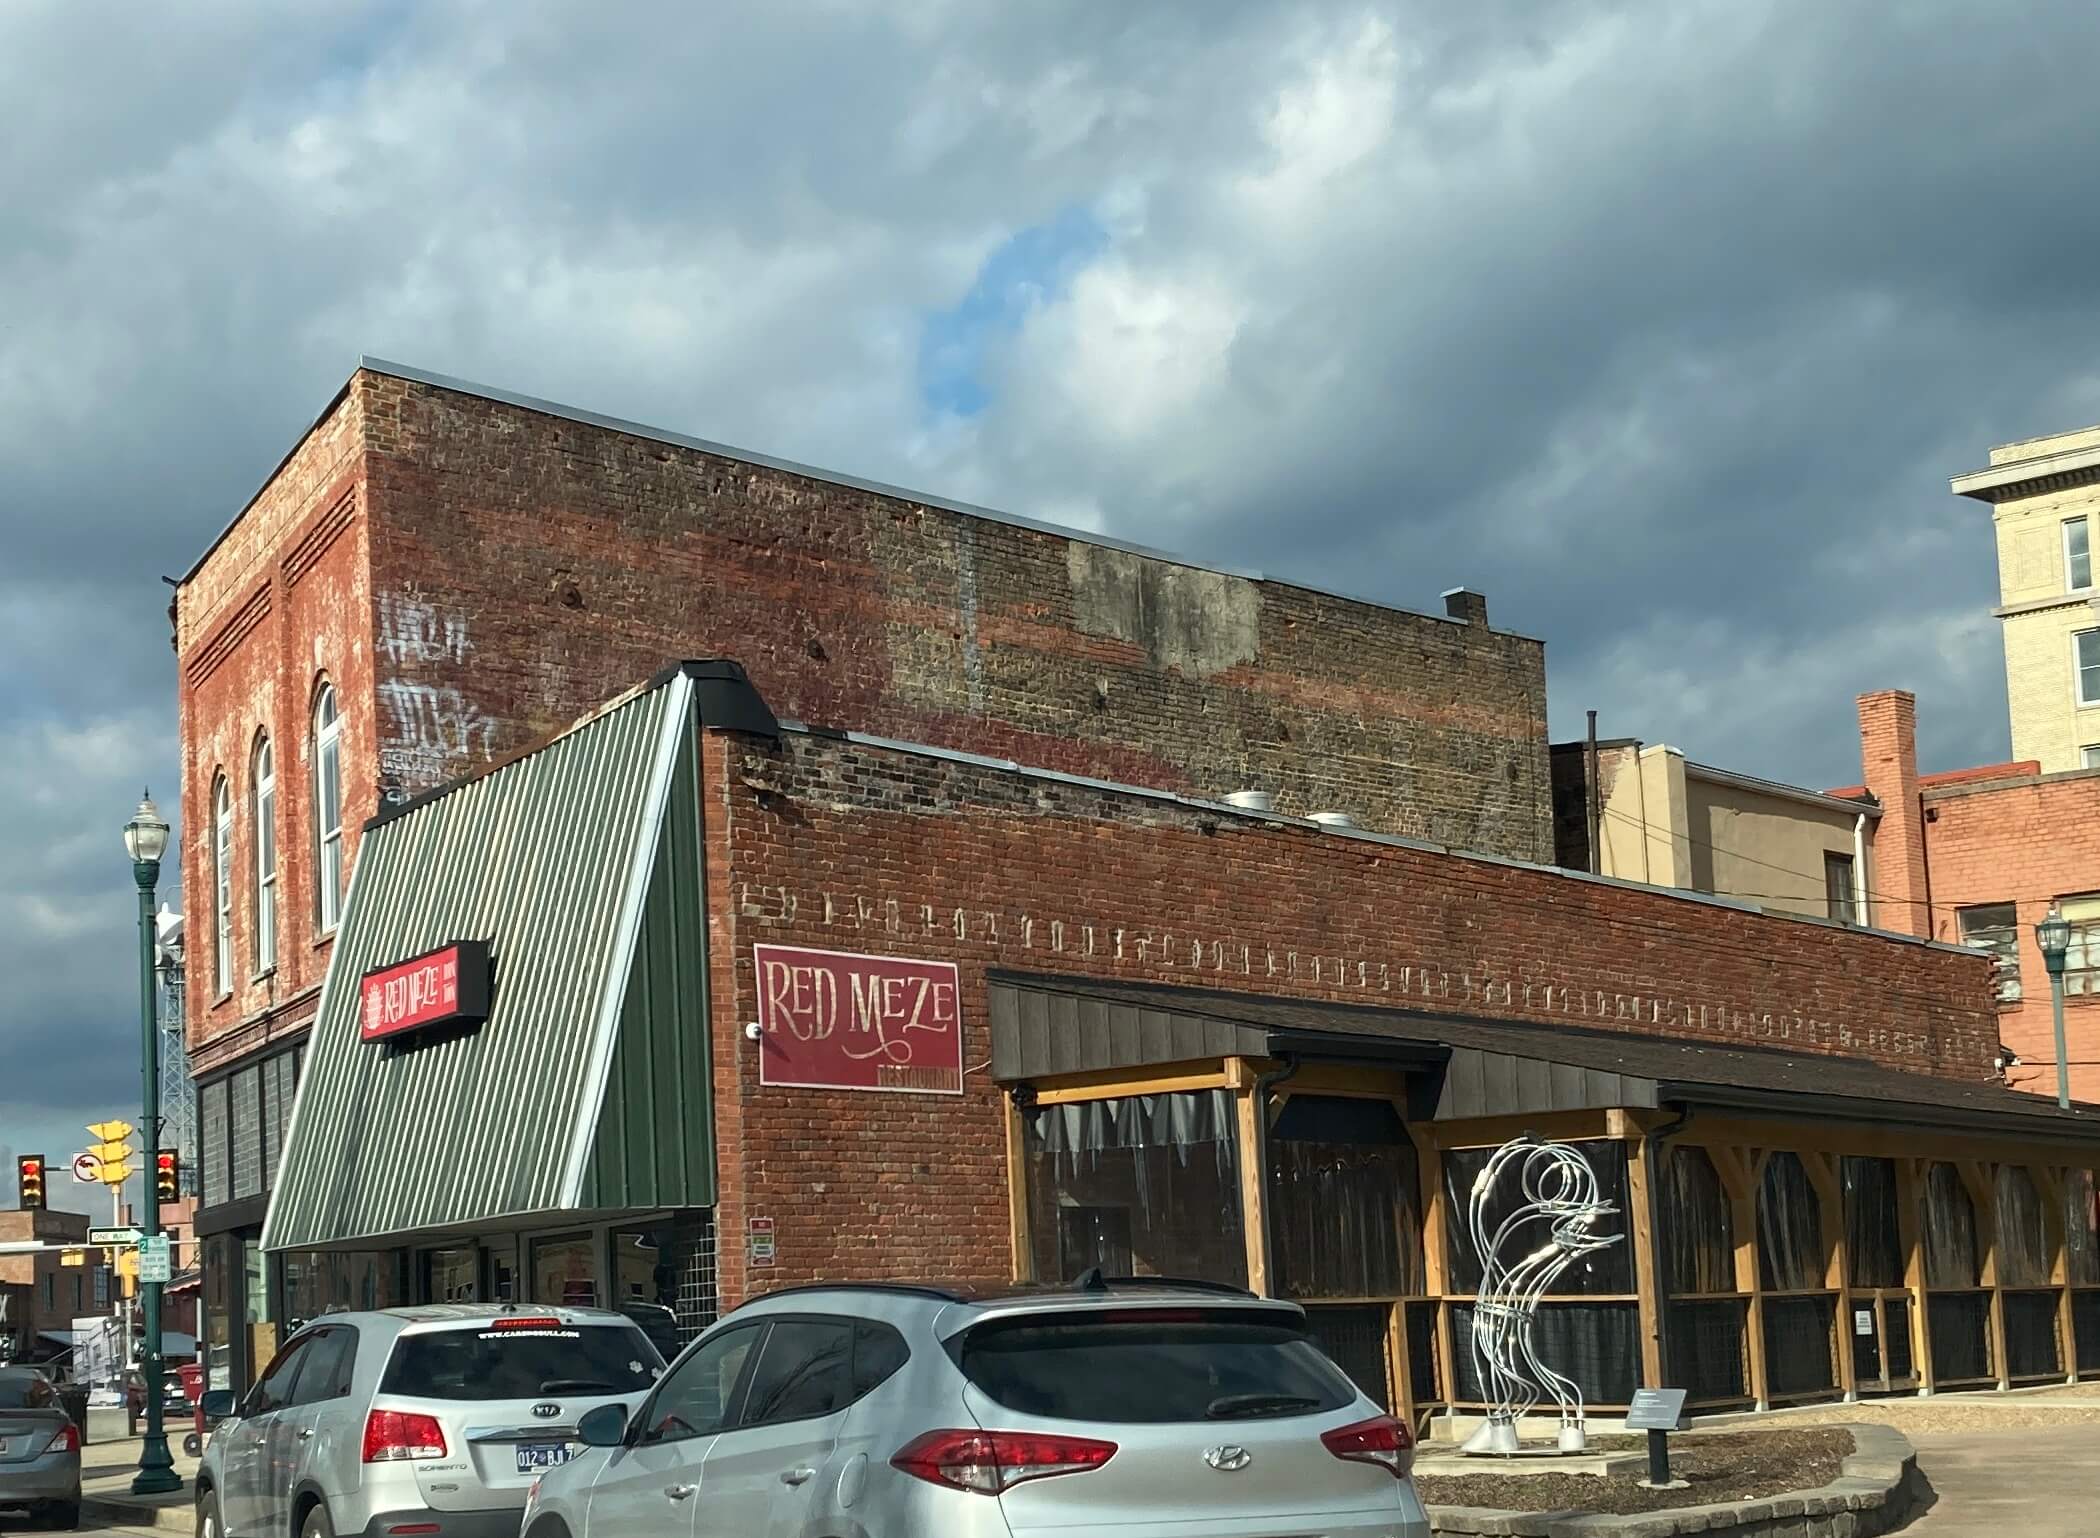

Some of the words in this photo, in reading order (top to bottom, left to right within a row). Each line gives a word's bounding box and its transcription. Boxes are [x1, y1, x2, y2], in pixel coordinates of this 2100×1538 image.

[384, 976, 407, 1024] RED
[407, 966, 439, 1017] MEZE
[763, 960, 837, 1041] RED
[841, 972, 954, 1064] MEZE
[94, 1233, 109, 1241] ONE
[112, 1232, 128, 1240] WAY
[140, 1240, 148, 1252] 2
[518, 1450, 539, 1467] 012
